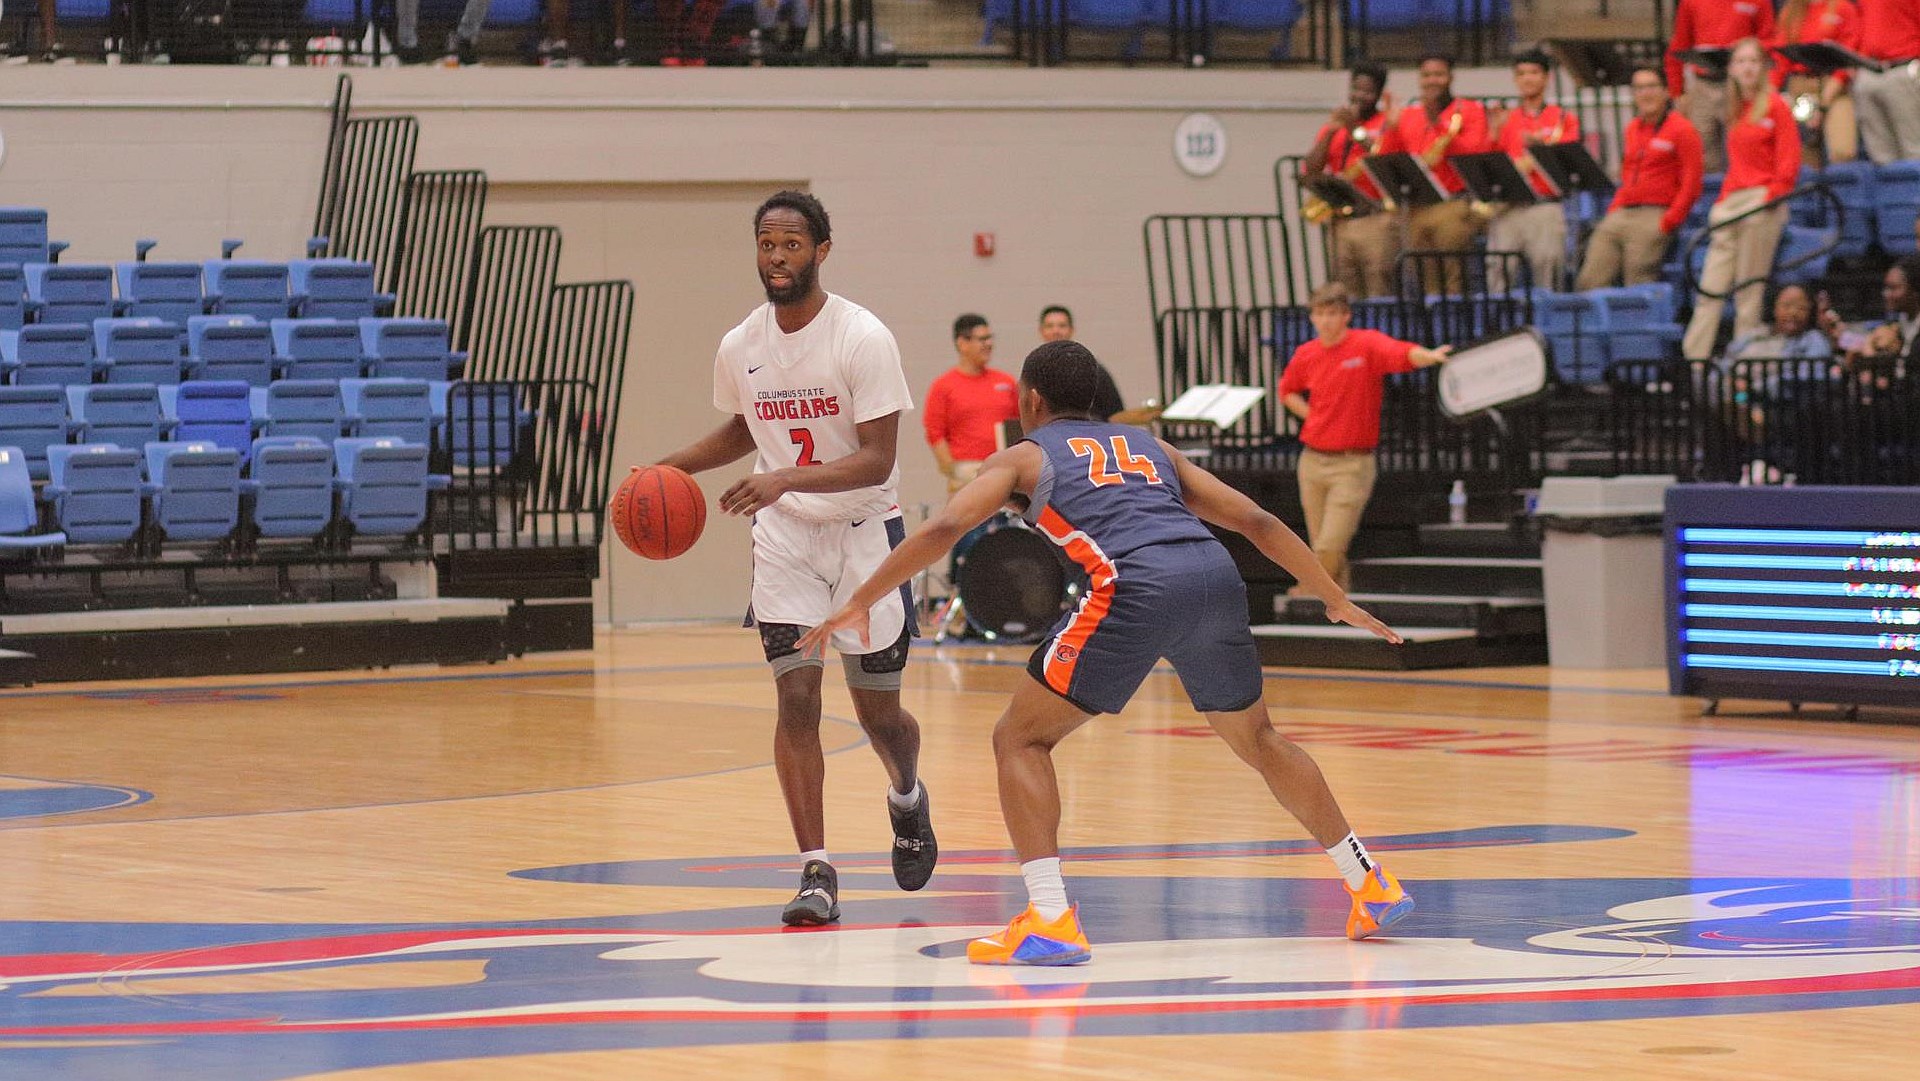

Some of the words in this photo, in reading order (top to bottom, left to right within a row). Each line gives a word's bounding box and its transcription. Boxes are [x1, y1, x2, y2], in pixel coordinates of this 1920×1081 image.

[757, 389, 797, 400] COLUMBUS
[798, 387, 825, 398] STATE
[789, 427, 823, 467] 2
[1066, 435, 1163, 488] 24
